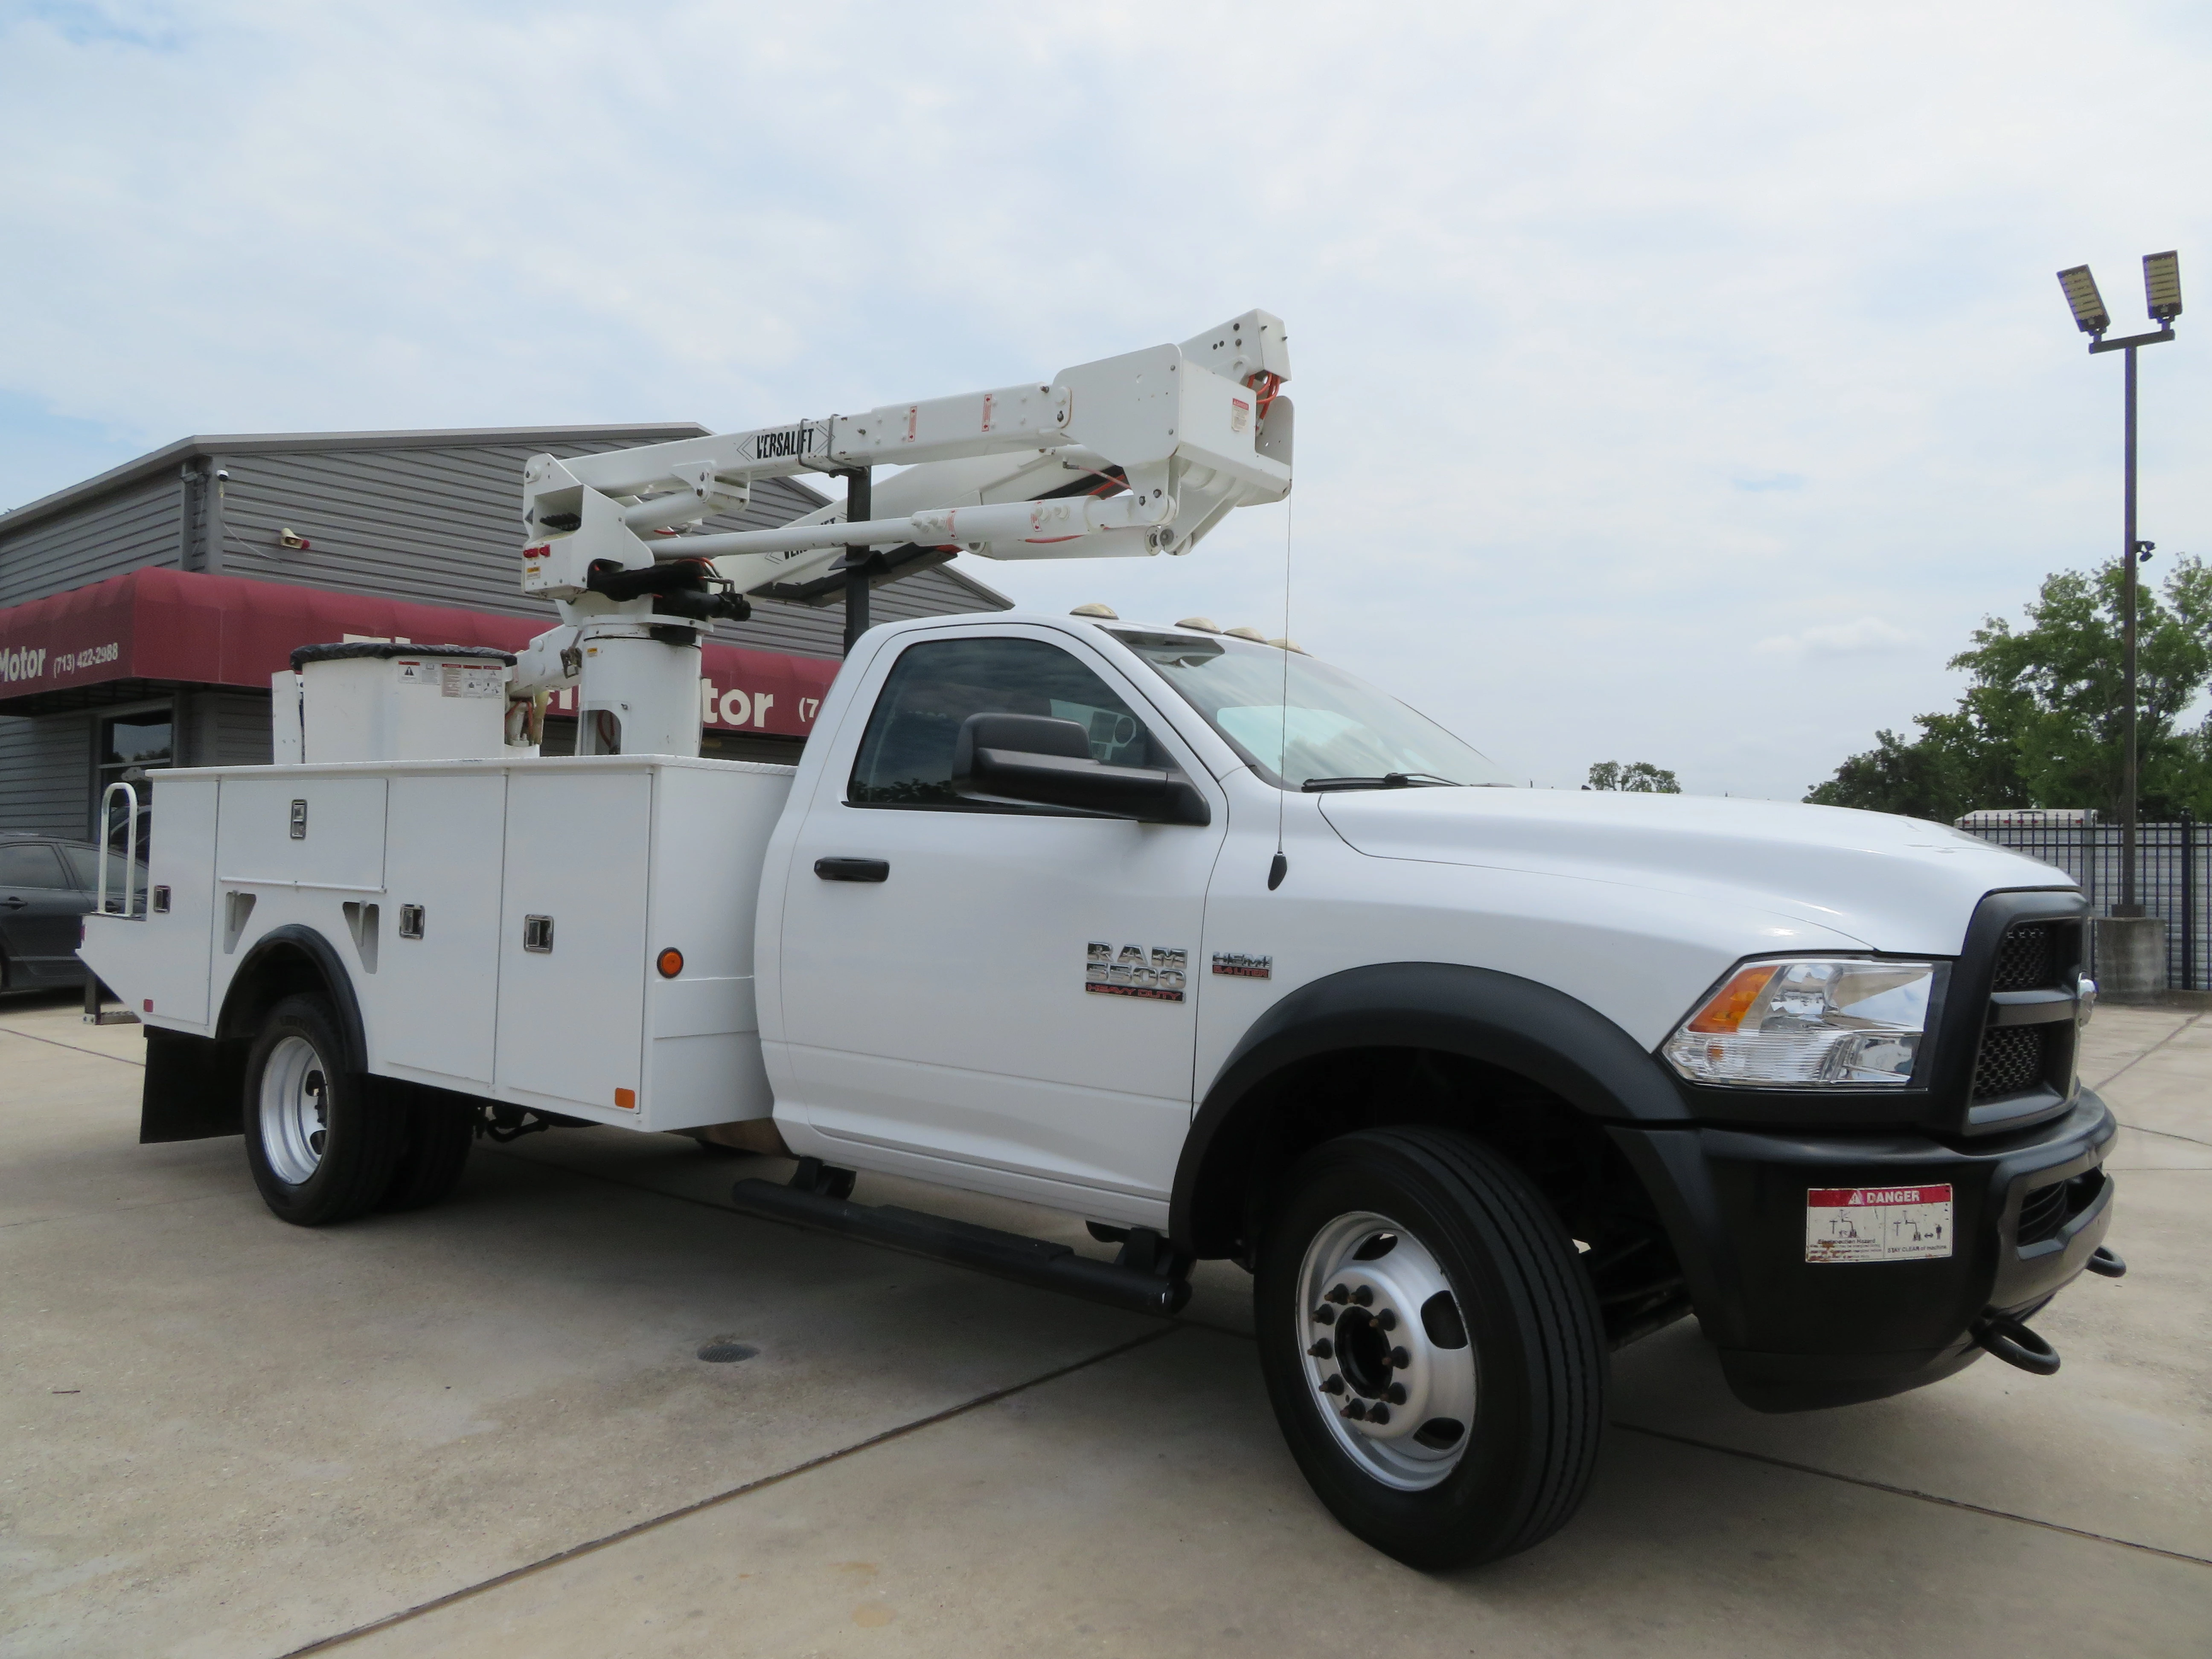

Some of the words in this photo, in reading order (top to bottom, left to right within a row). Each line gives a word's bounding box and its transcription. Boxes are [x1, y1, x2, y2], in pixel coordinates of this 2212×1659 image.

[757, 428, 814, 459] VERSALIFT
[0, 646, 46, 682] Motor
[54, 654, 75, 678] (713)
[76, 642, 119, 668] 422-2988
[701, 678, 774, 728] tor
[1087, 941, 1187, 969] RAM
[1213, 952, 1272, 968] HEMI
[1086, 961, 1187, 990] 5500
[1234, 967, 1268, 977] LITER
[1088, 984, 1136, 995] HEAVY
[1138, 989, 1181, 1000] DUTY
[1866, 1190, 1920, 1204] DANGER
